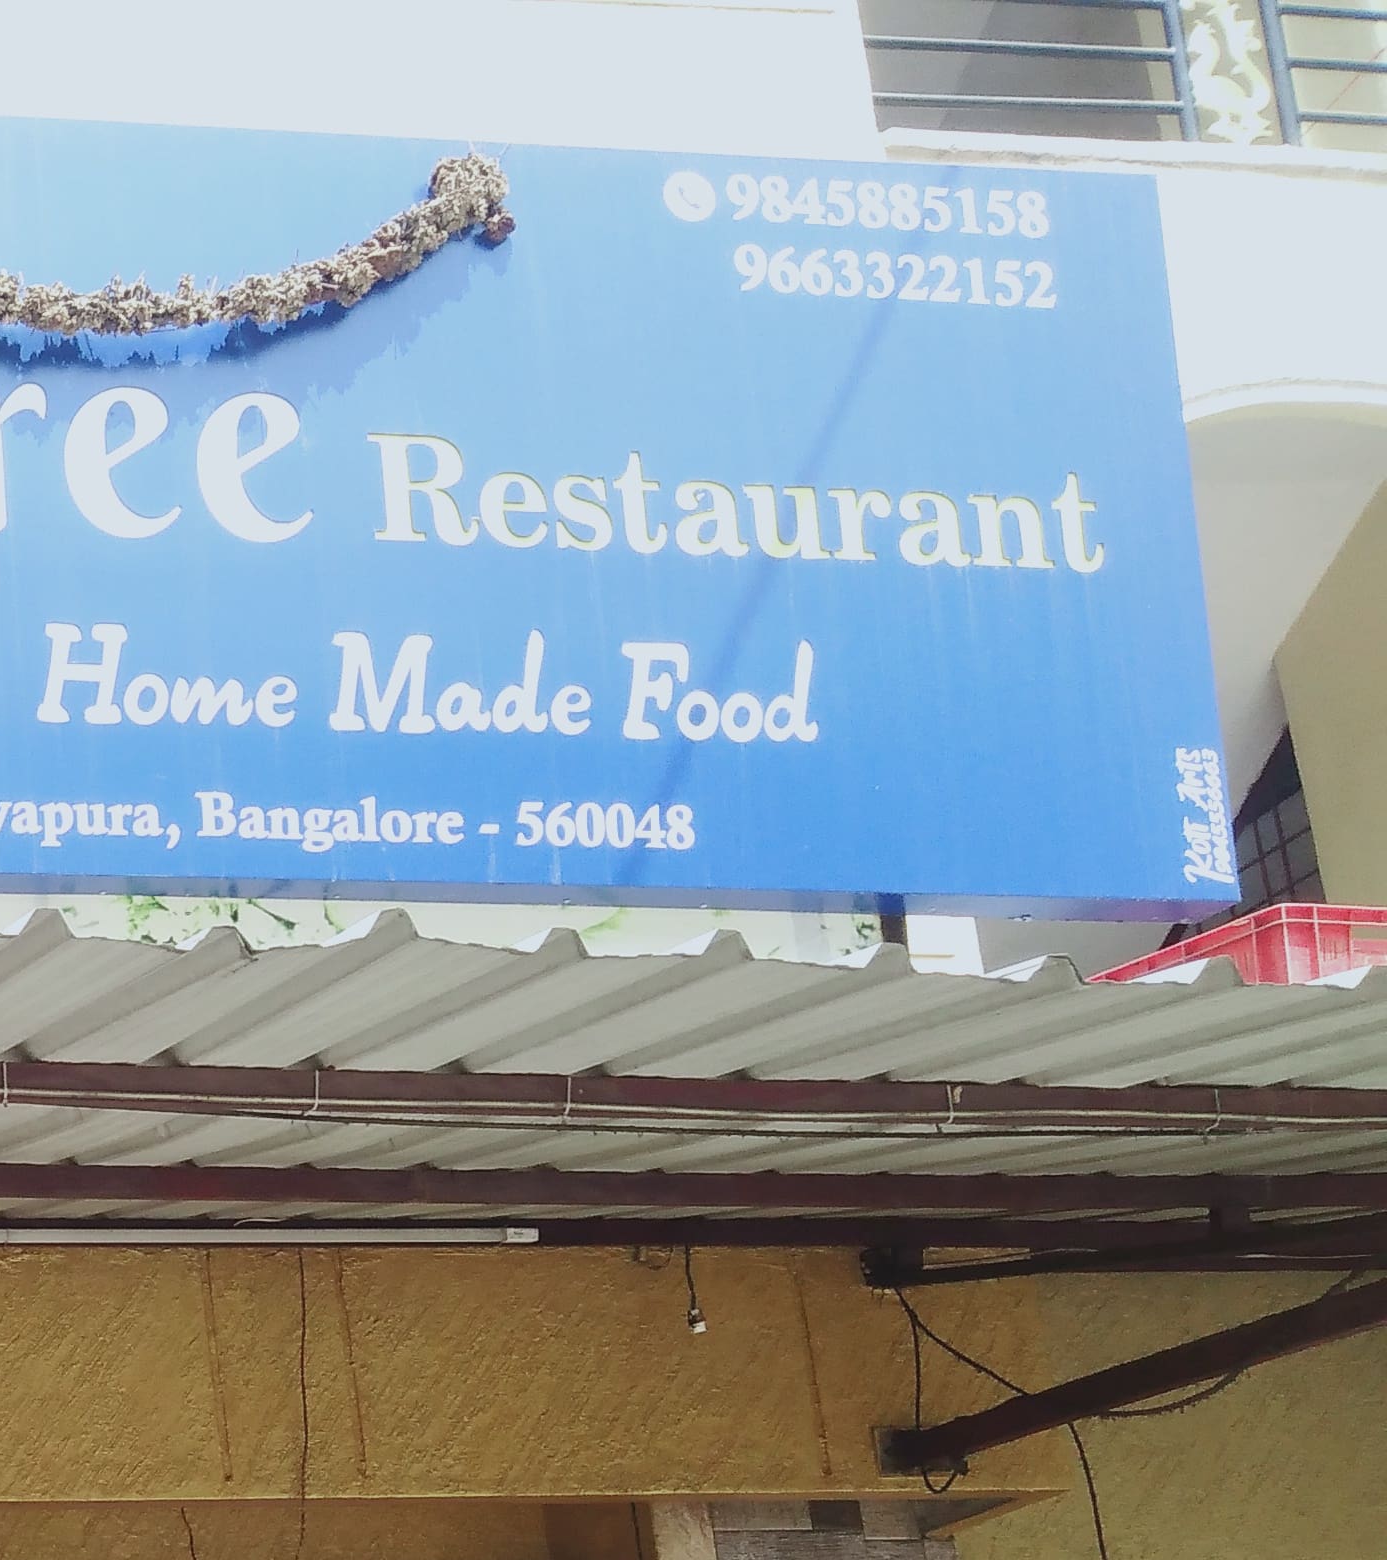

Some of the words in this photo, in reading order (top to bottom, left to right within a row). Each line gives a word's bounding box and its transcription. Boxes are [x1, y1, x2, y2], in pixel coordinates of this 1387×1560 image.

[727, 173, 1050, 240] 9845885158
[734, 243, 1057, 309] 9663322152
[367, 433, 1105, 574] Restaurant
[36, 622, 298, 728] Home
[328, 629, 592, 736] Made
[620, 640, 819, 743] Food
[194, 790, 465, 853] Bangalore
[515, 801, 696, 851] 560048
